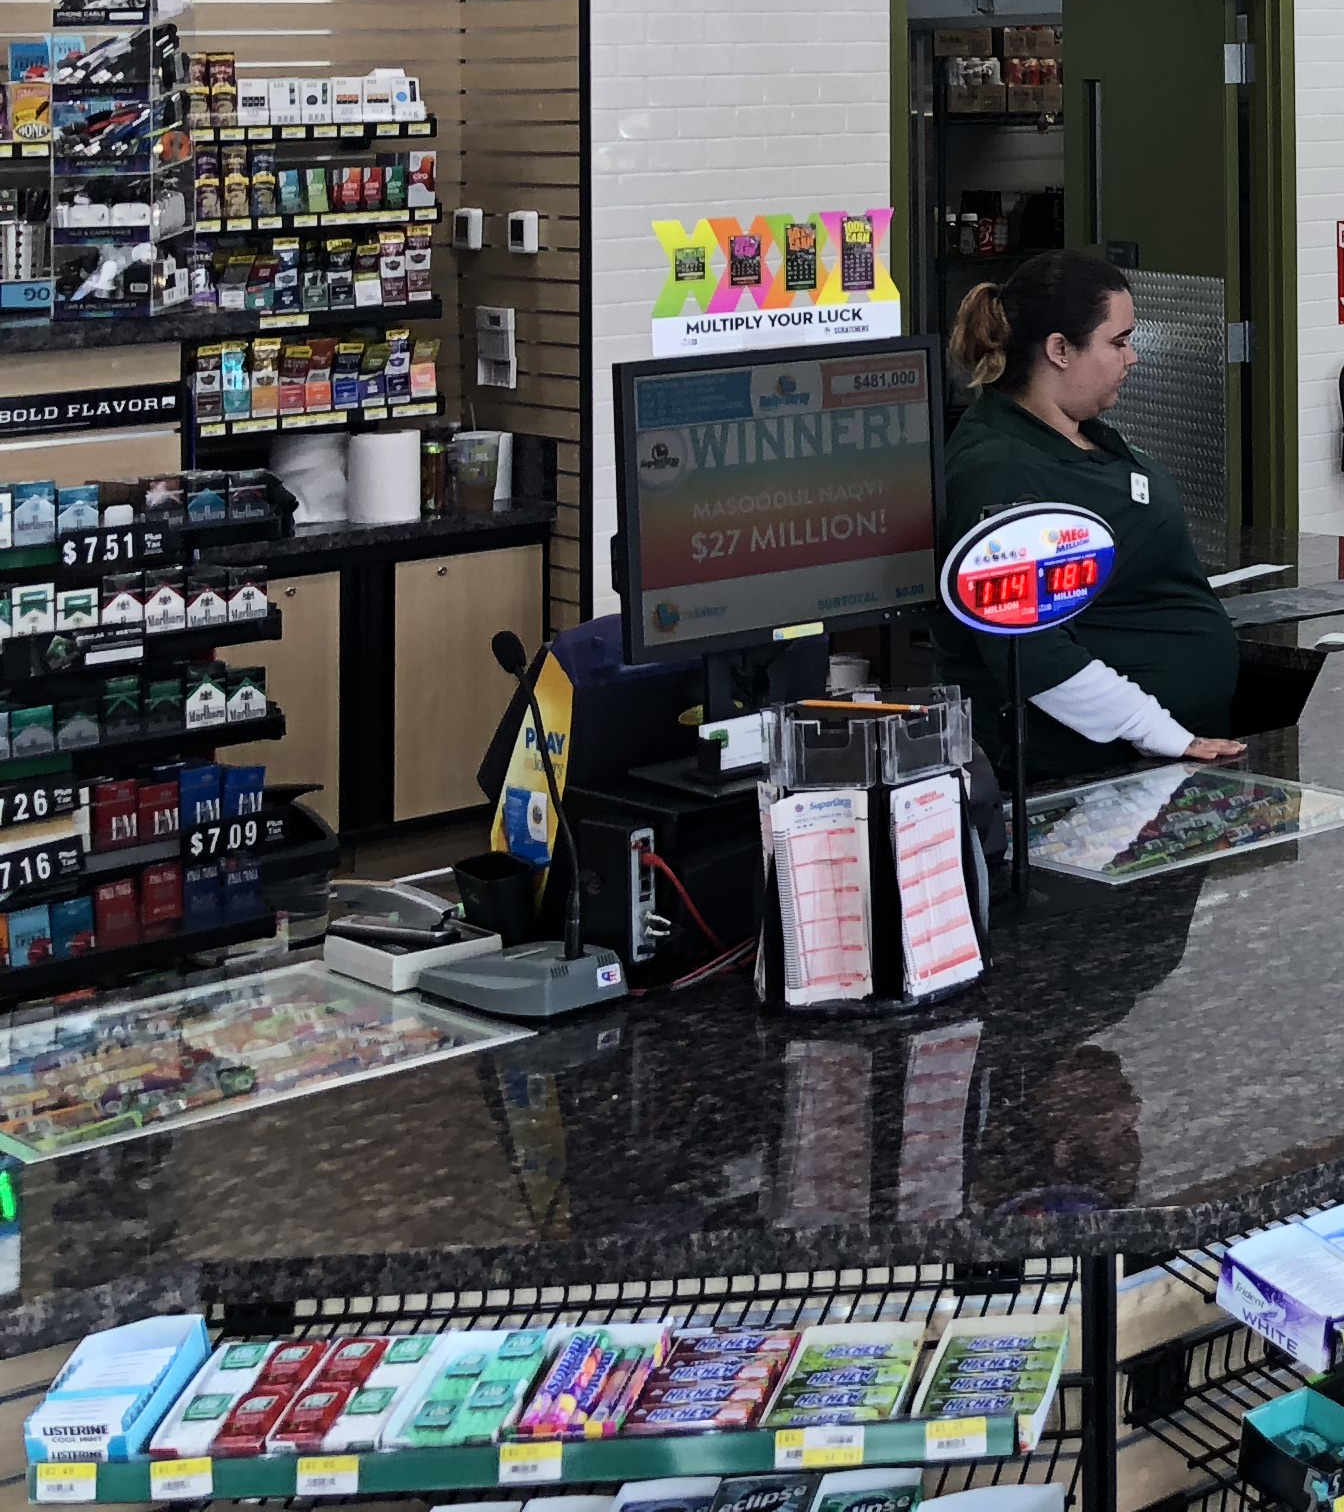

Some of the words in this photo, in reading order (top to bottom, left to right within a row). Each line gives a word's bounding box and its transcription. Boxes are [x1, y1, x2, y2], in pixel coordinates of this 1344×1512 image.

[686, 315, 763, 334] MULTIPLY
[768, 312, 813, 327] YOUR
[818, 308, 863, 323] LUCK
[853, 371, 916, 391] $481,000
[0, 406, 58, 424] BOLD
[67, 397, 159, 417] FLAVOR
[688, 402, 908, 469] WINNER!
[690, 530, 742, 563] $27
[750, 509, 887, 552] MILLION!
[1059, 528, 1090, 543] MEGA
[1053, 558, 1095, 591] 187
[818, 593, 879, 611] SUBTOTAL
[983, 574, 1025, 605] 114
[1053, 588, 1088, 601] MILLION
[984, 601, 1019, 615] MILLION
[189, 704, 225, 723] Marlboro
[1234, 1280, 1265, 1310] Trident
[1241, 1307, 1299, 1356] WHITE
[549, 1335, 585, 1394] mentos
[42, 1425, 109, 1437] LISTERINE
[718, 1484, 807, 1512] eclipse
